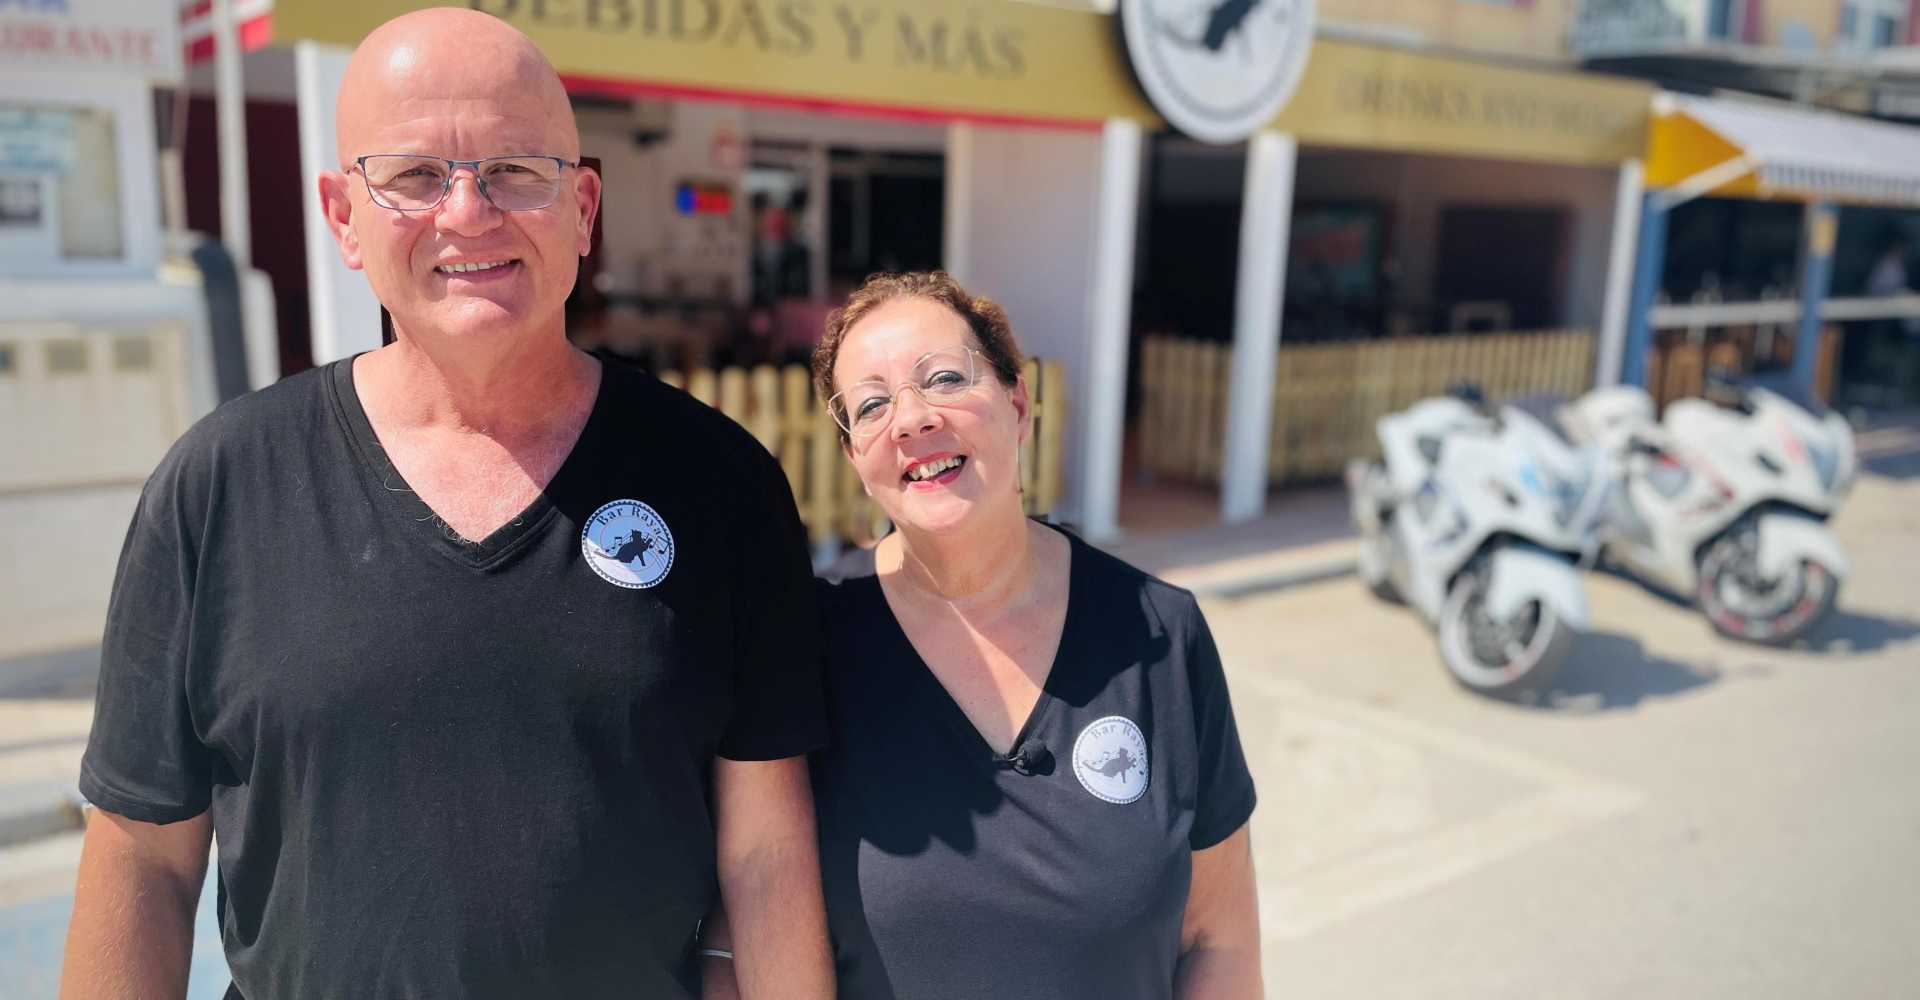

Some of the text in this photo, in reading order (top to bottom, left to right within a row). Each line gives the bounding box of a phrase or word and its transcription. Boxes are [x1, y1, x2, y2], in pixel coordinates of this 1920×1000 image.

[466, 0, 816, 54] BIDAS
[834, 5, 882, 62] Y
[596, 506, 661, 535] Bar Raya
[1092, 723, 1116, 738] Bar
